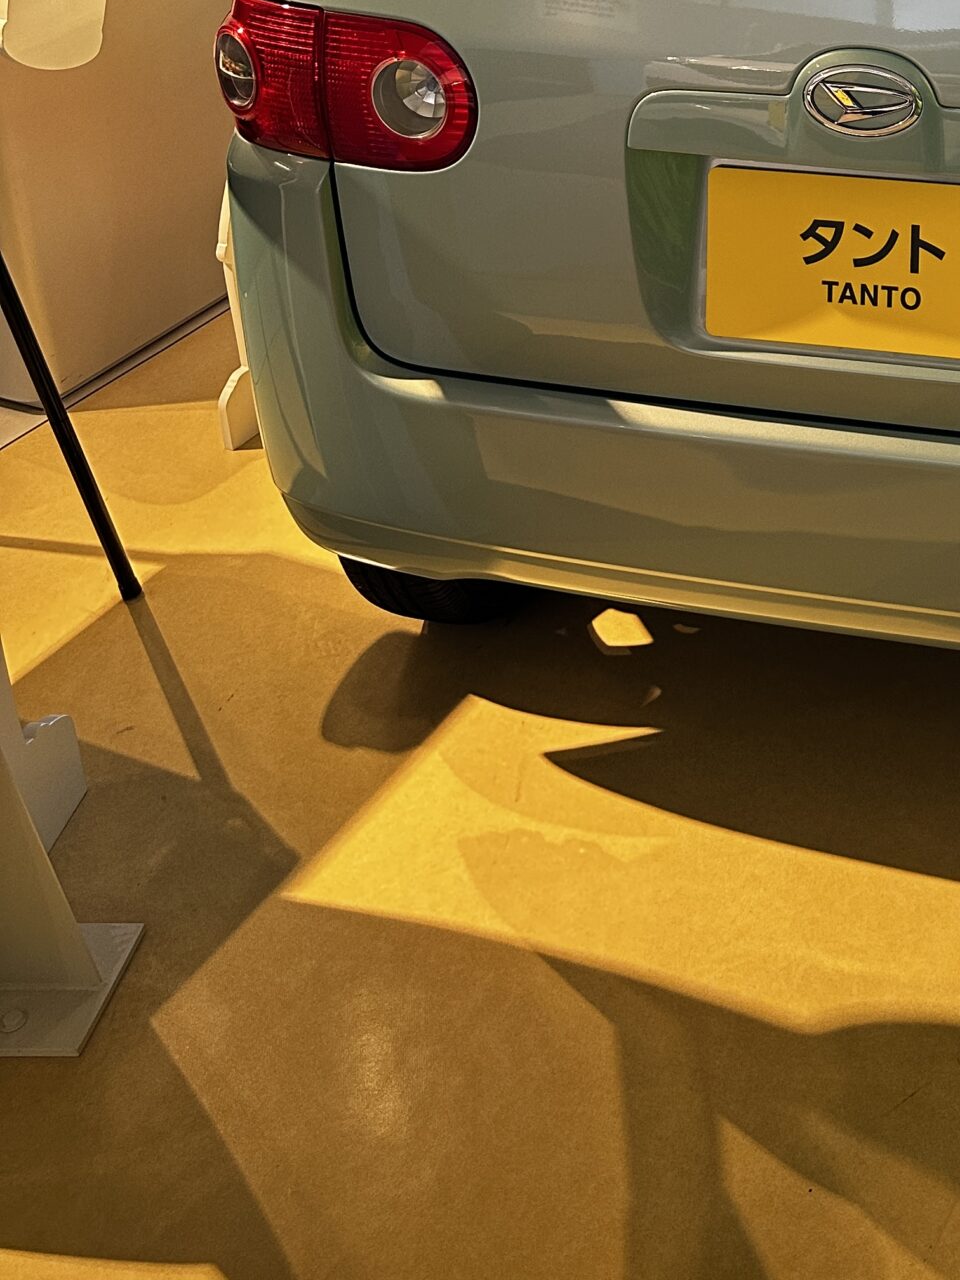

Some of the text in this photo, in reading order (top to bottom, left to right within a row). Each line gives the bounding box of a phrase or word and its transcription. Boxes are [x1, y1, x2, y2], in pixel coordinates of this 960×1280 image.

[799, 218, 946, 274] タント
[821, 279, 922, 311] TANTO
